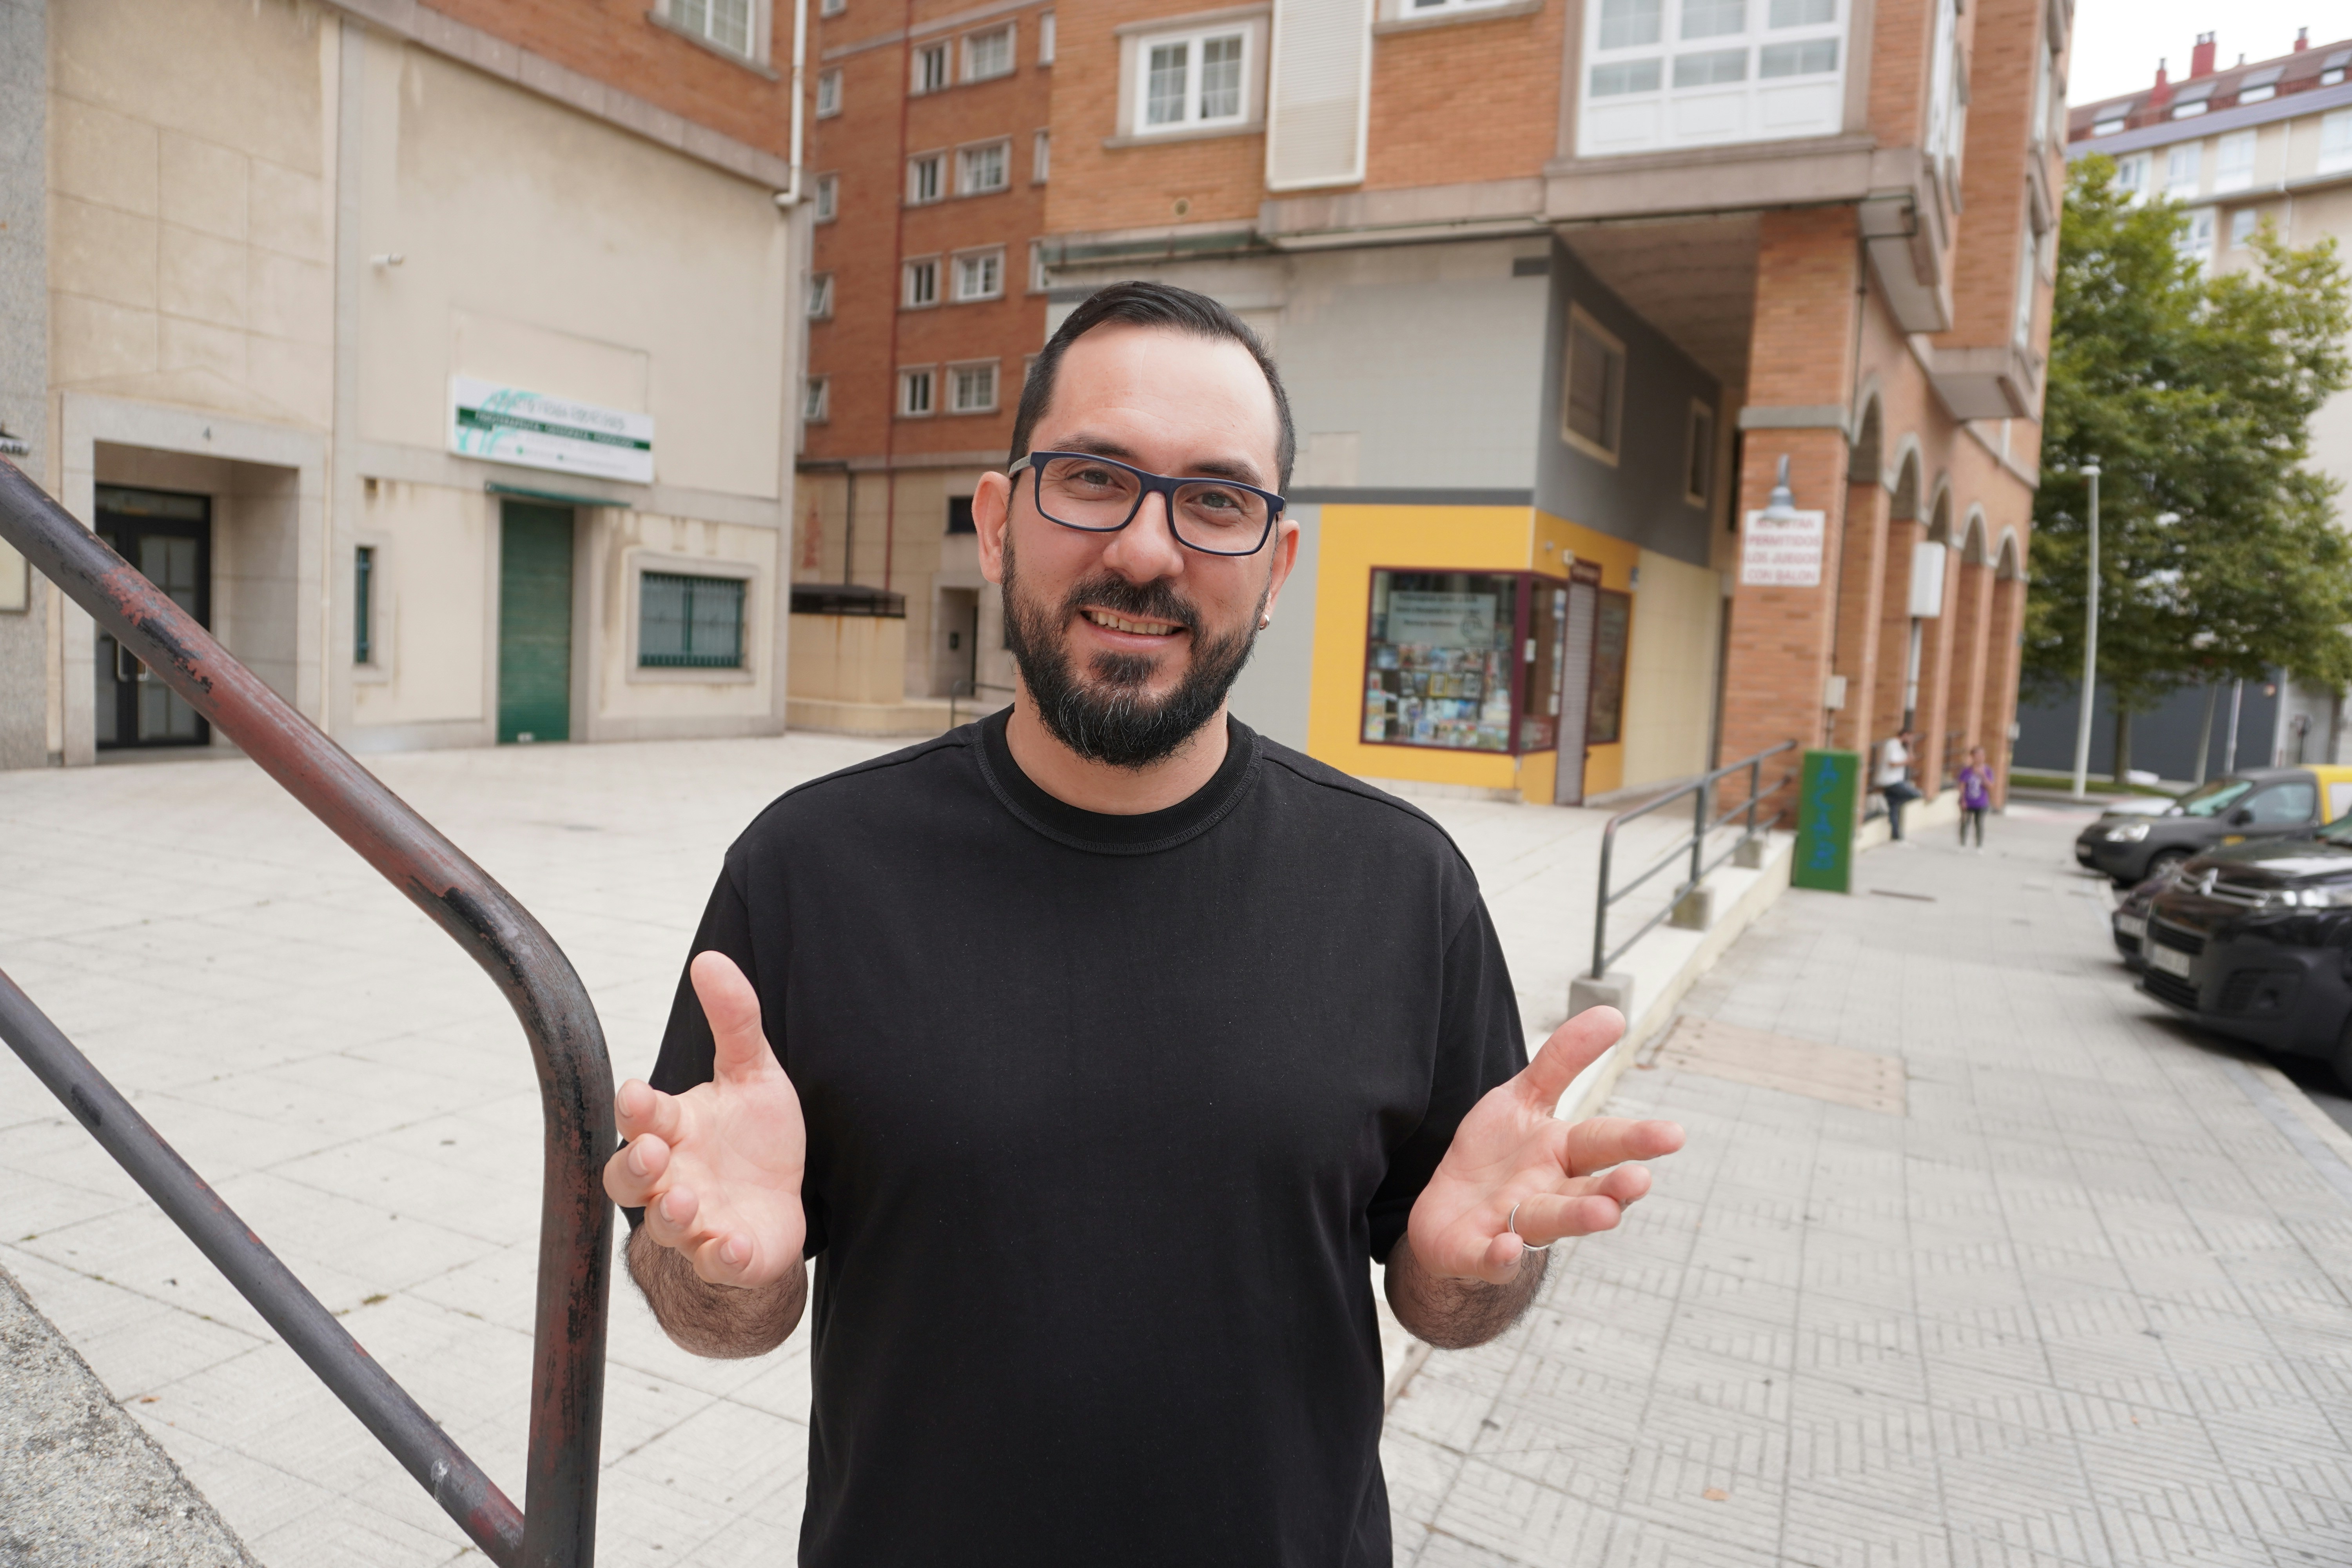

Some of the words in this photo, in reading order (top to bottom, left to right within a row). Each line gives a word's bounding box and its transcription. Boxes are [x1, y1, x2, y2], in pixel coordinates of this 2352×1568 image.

[1748, 534, 1820, 546] PERMITIDOS
[1746, 552, 1767, 564] LOS
[1772, 552, 1819, 564] JUEGOS
[1747, 569, 1773, 580] CON
